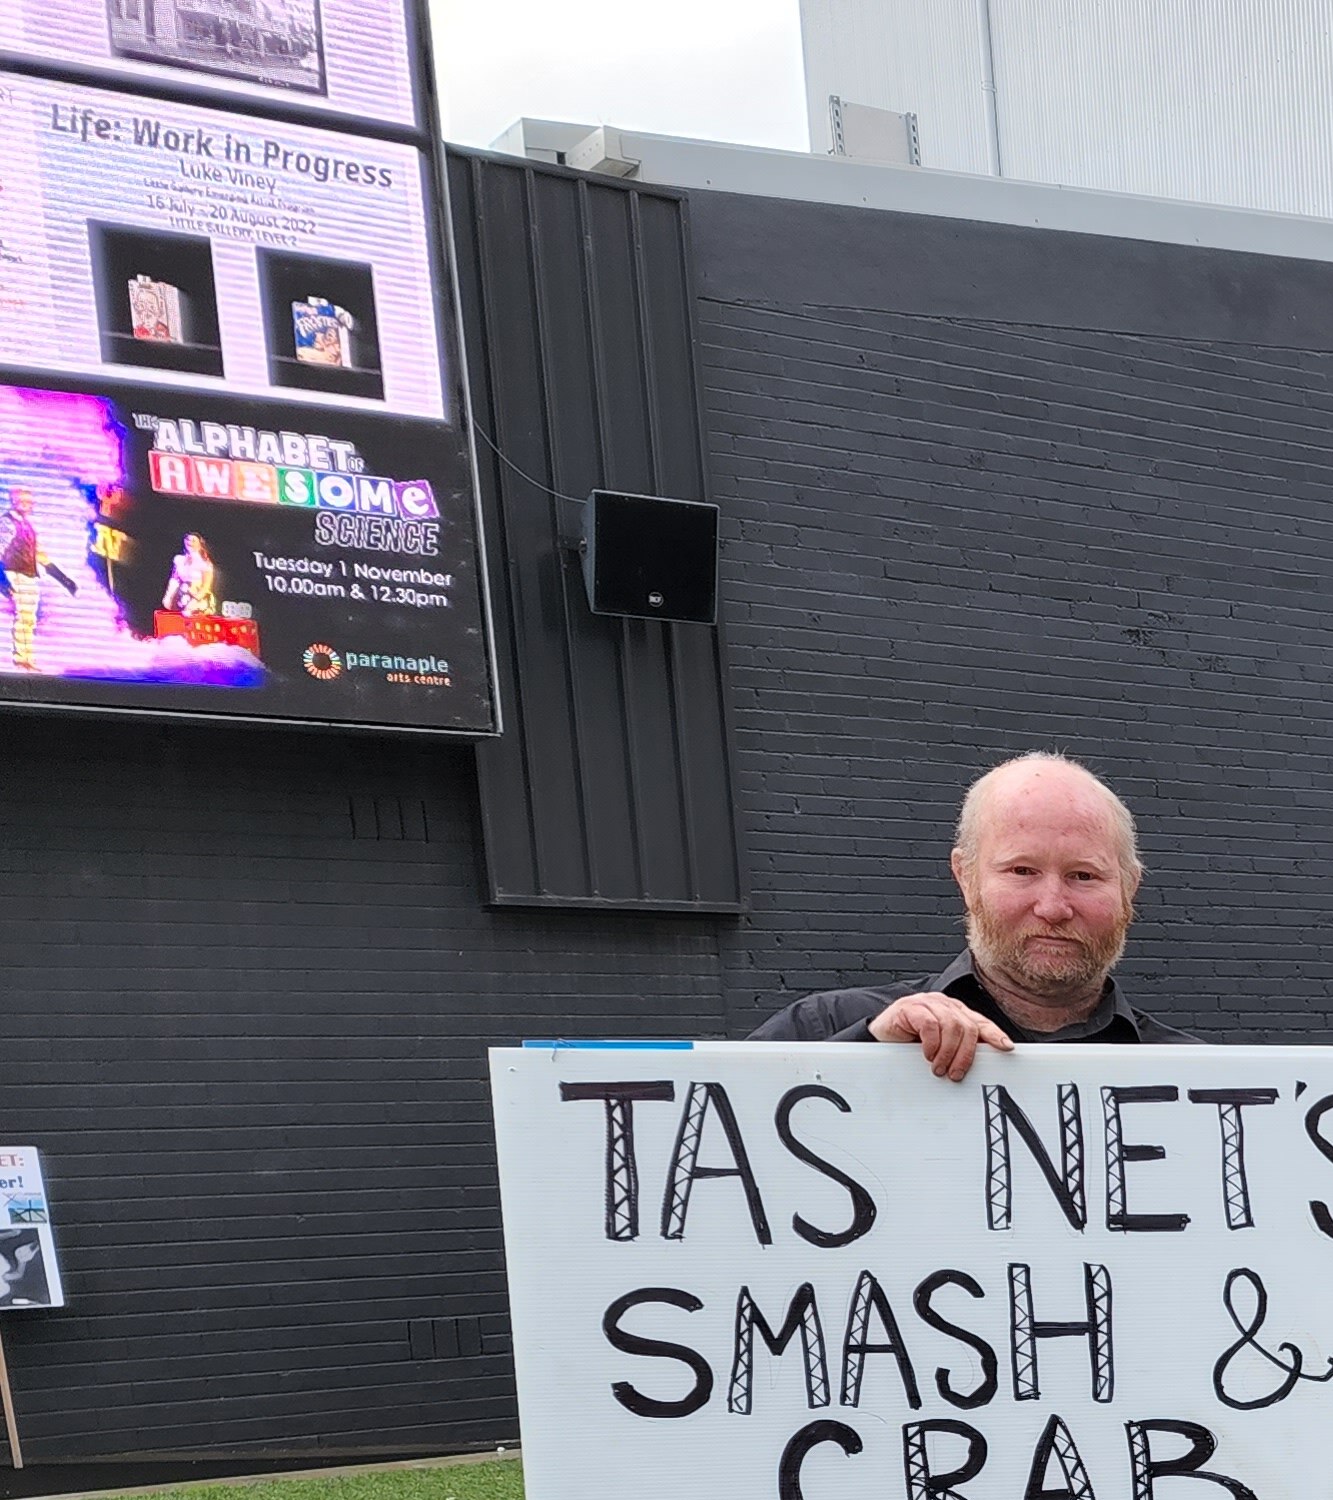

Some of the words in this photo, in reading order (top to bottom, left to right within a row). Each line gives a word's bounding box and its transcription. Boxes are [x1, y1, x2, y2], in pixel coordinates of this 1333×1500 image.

[52, 103, 122, 142] Life:
[132, 117, 214, 157] Work
[224, 133, 251, 163] in
[263, 139, 393, 188] Progress
[178, 158, 223, 182] Luke
[225, 166, 277, 195] Viney
[168, 196, 195, 218] July
[209, 203, 228, 220] 20
[230, 207, 280, 230] August
[281, 215, 317, 236] 2022
[153, 417, 356, 474] ALPHABET
[314, 510, 441, 556] SCIENCE
[252, 550, 334, 578] Tuesday
[338, 559, 348, 577] 1
[354, 562, 452, 587] November
[264, 574, 346, 598] 10.00am
[349, 583, 367, 601] &
[370, 584, 450, 609] 12.30pm
[345, 651, 450, 675] paranaple
[386, 671, 411, 684] arts
[413, 674, 452, 688] centre
[557, 1078, 878, 1250] TAS
[601, 1261, 1115, 1419] SMASH
